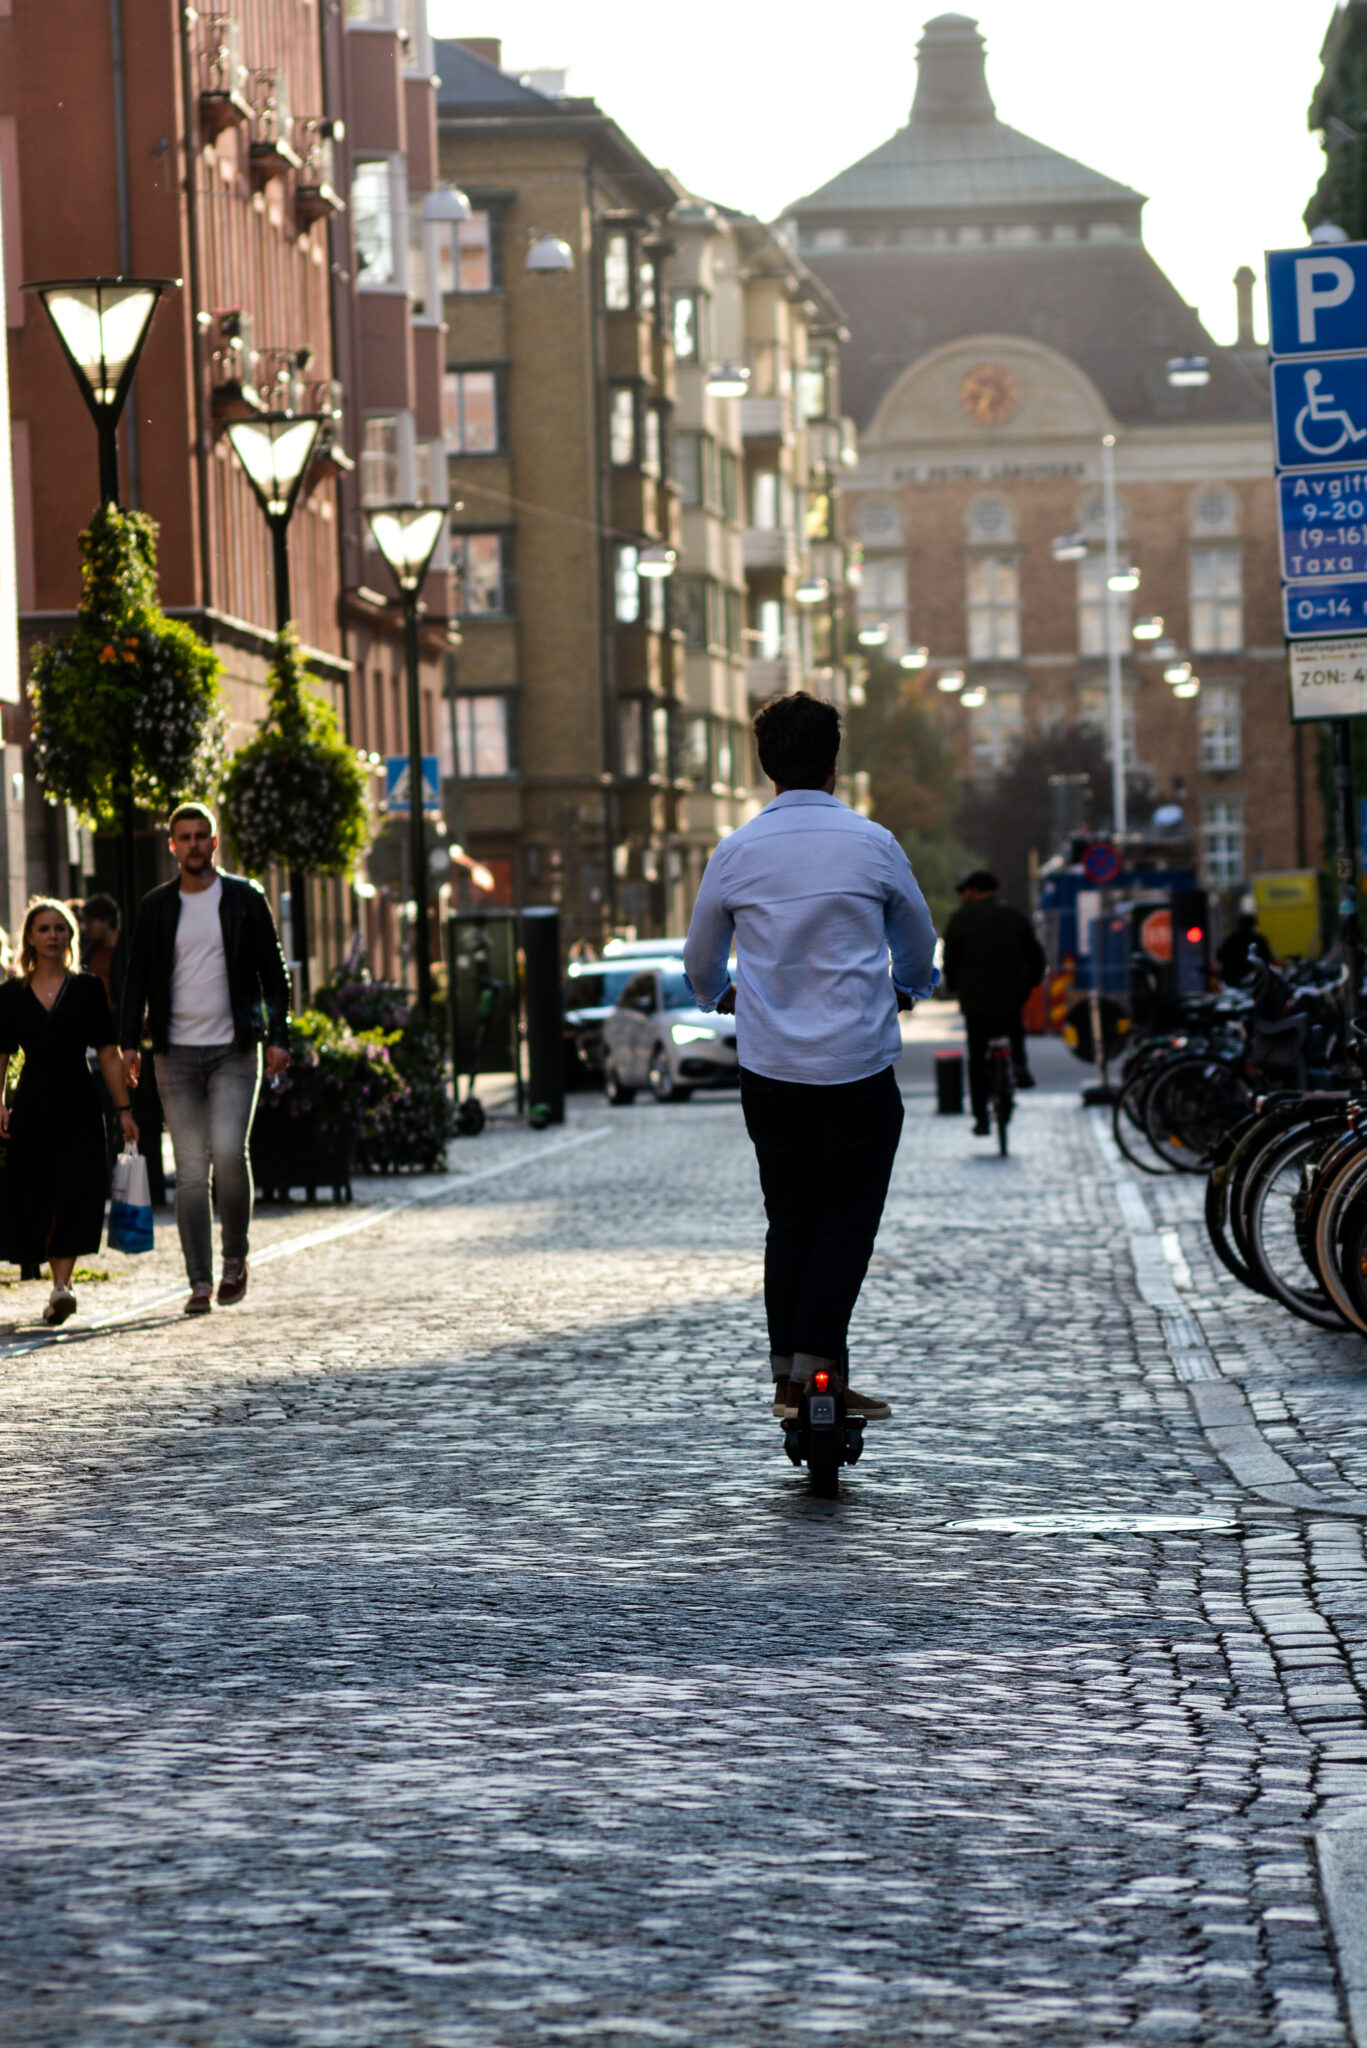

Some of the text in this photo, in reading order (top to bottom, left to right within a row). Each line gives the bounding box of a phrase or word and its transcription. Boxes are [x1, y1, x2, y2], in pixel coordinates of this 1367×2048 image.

[1294, 257, 1355, 343] P
[1303, 500, 1364, 522] 9-20
[1292, 556, 1353, 574] Taxa
[1297, 598, 1351, 619] 0-14
[1301, 667, 1367, 687] ZON: 4
